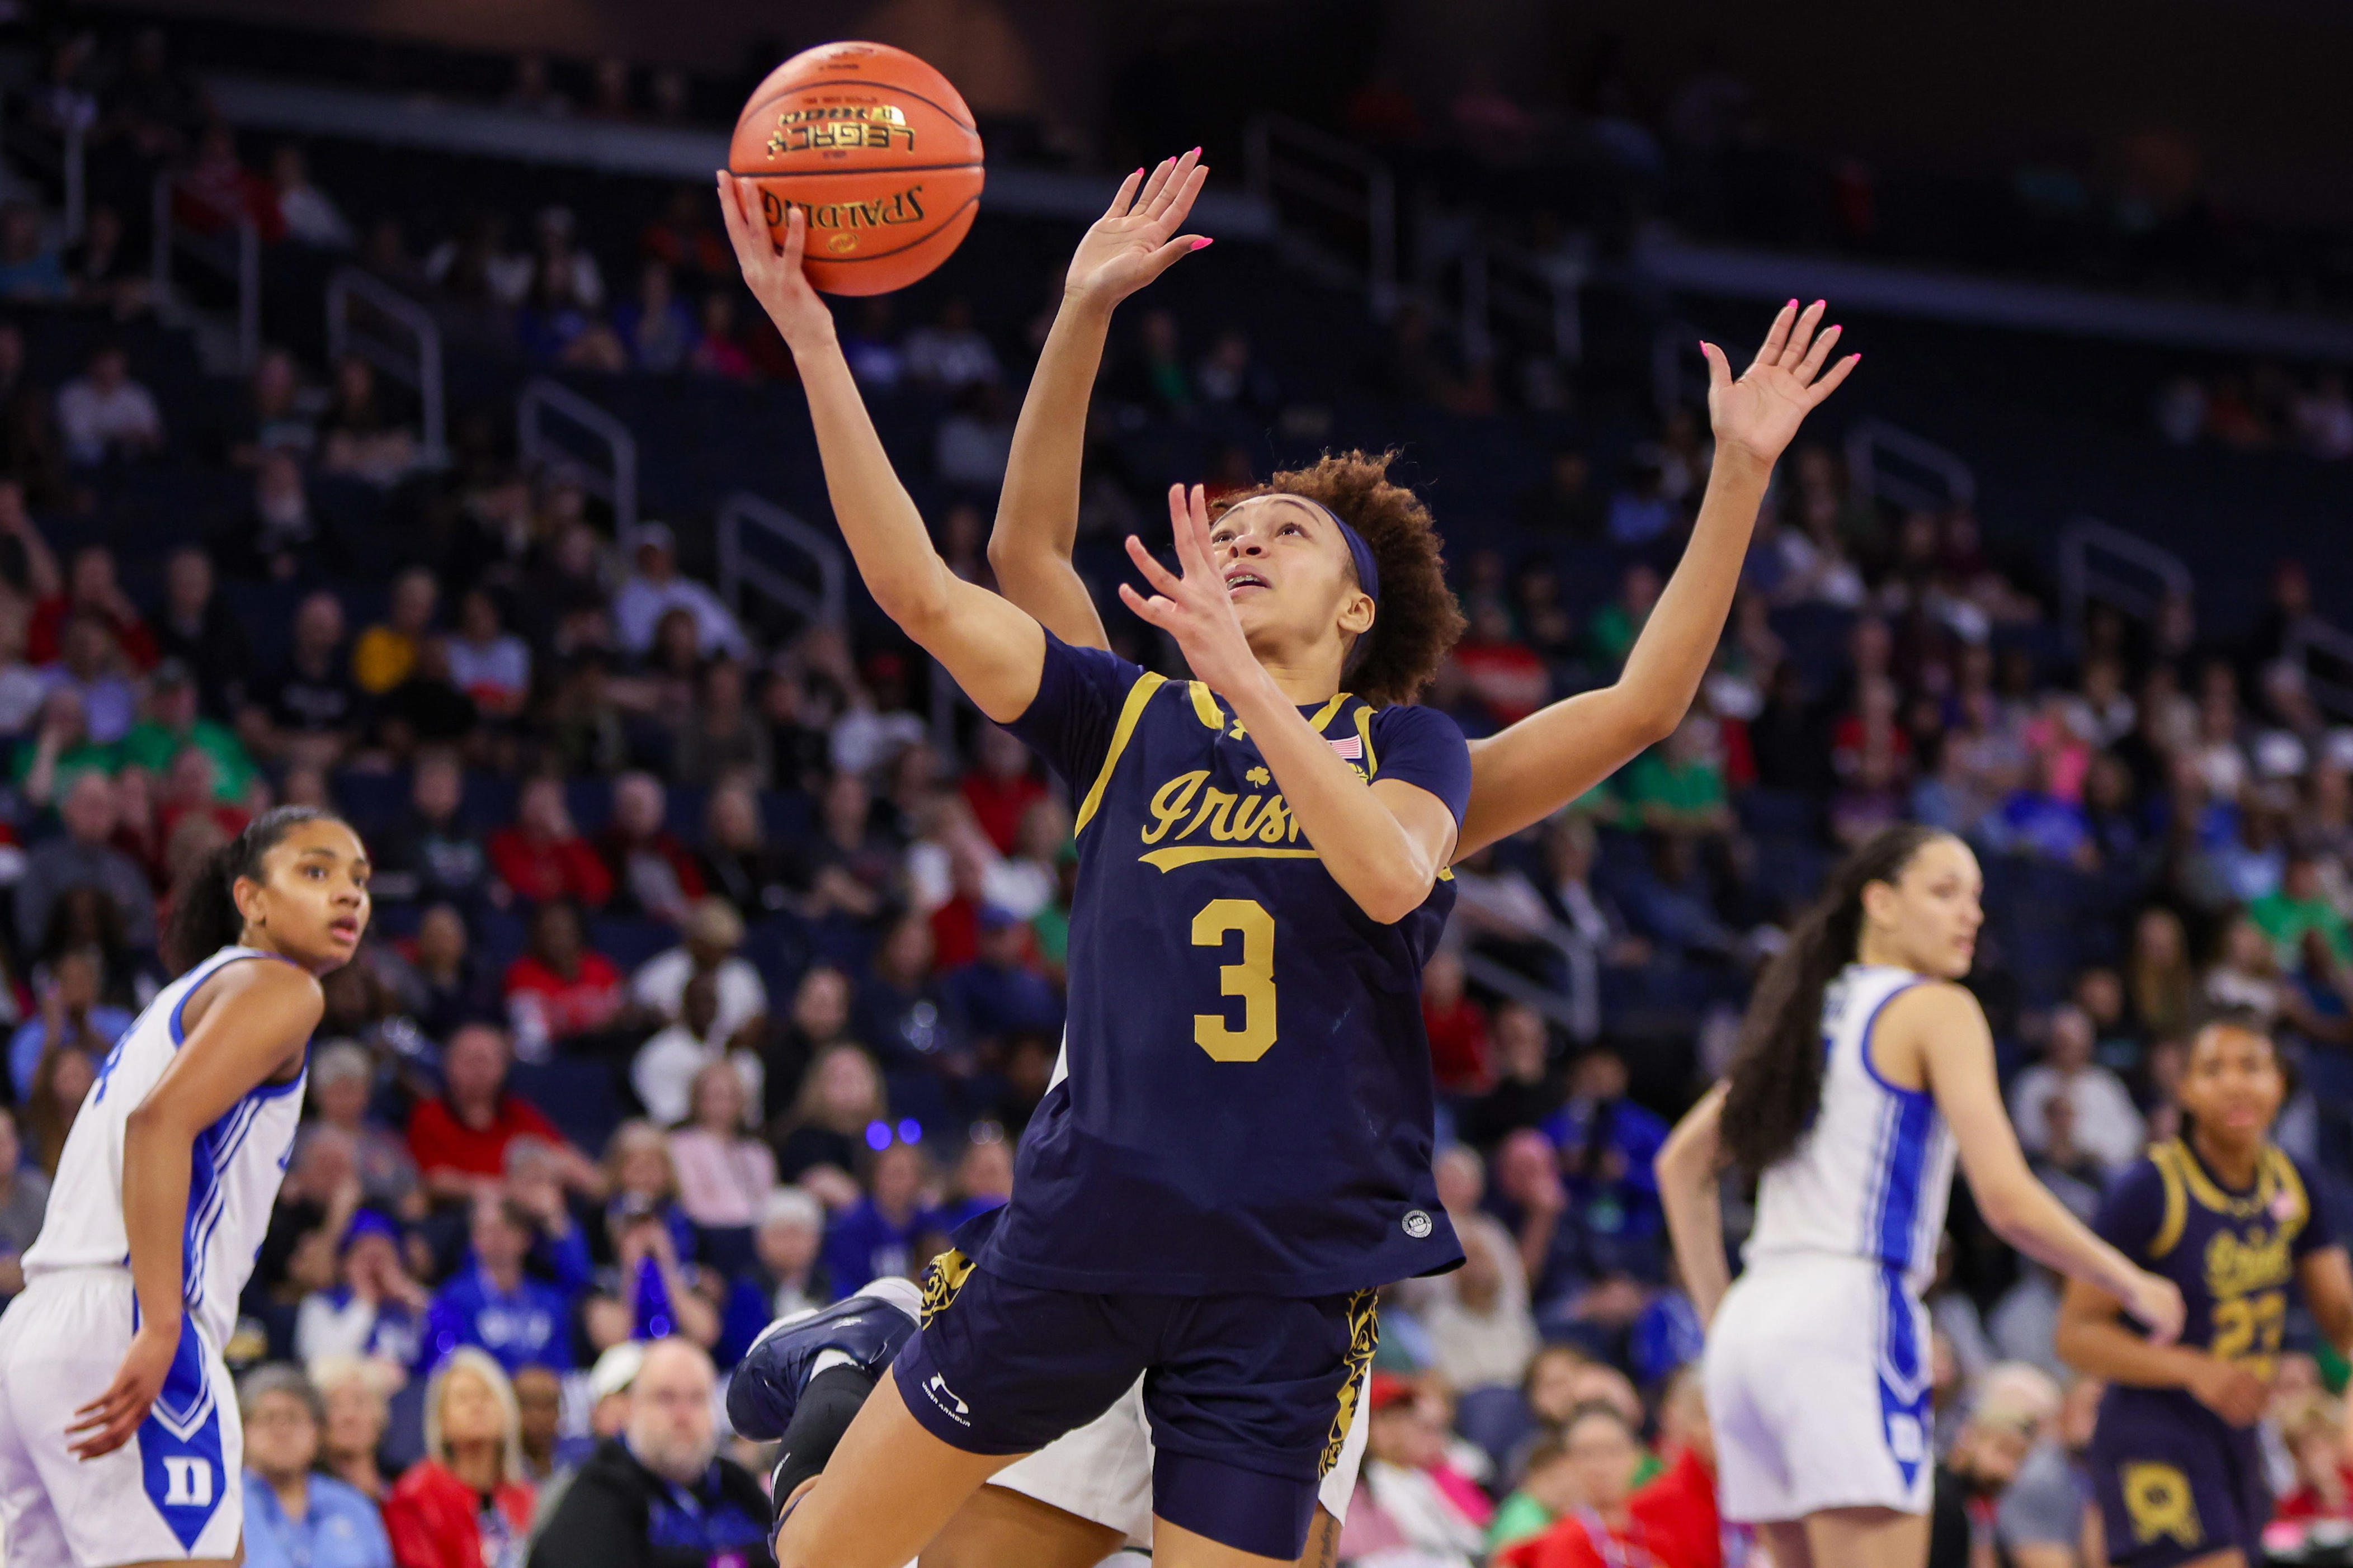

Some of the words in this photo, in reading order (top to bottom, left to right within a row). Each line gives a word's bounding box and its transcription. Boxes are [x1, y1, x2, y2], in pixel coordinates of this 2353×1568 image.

[767, 121, 915, 161] LEGACY
[1191, 899, 1277, 1062] 3
[922, 1381, 939, 1404] UNDER
[939, 1403, 971, 1428] ARMOUR
[162, 1456, 212, 1506] D
